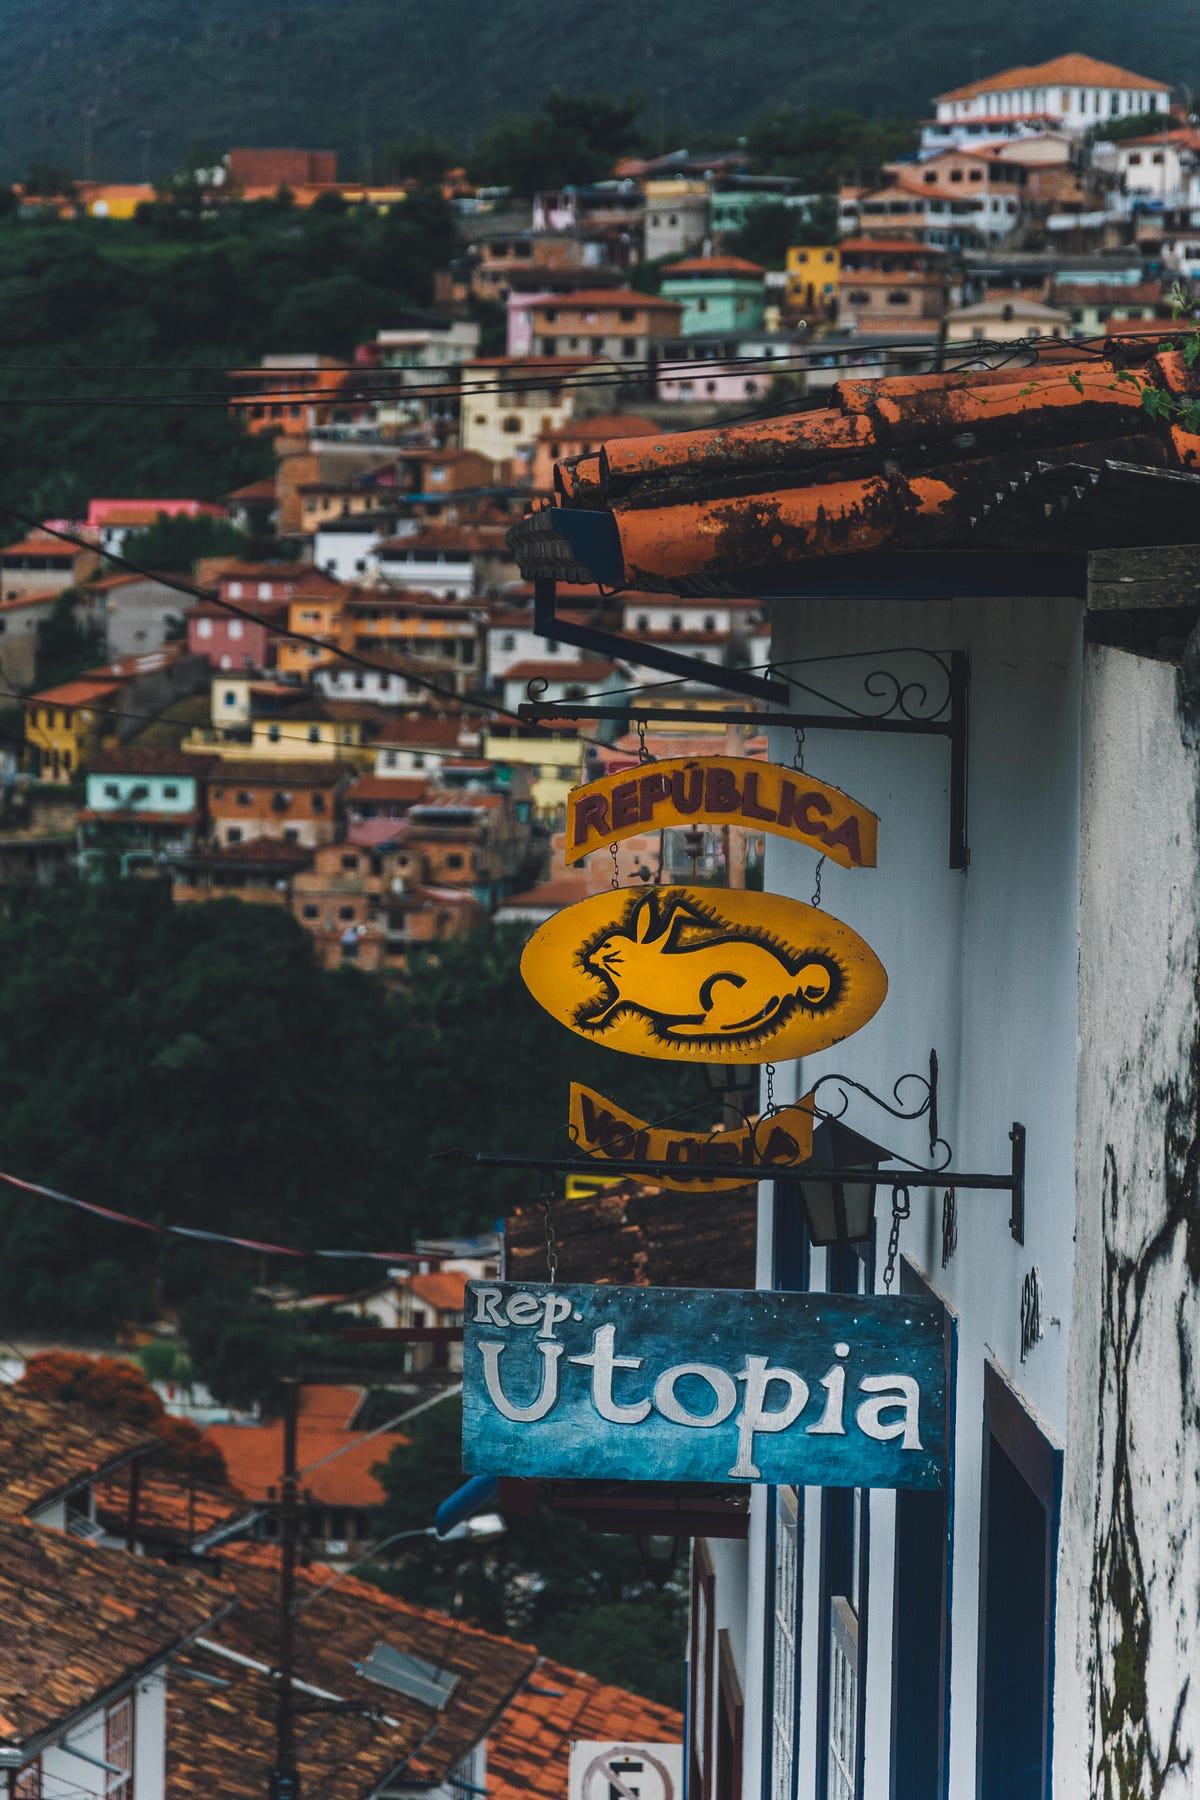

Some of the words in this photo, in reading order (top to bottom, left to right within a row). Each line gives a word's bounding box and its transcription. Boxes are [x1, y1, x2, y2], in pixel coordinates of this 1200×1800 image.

[573, 761, 863, 866] REPÚBLICA
[472, 1288, 583, 1339] Rep.
[477, 1323, 924, 1478] Utopia
